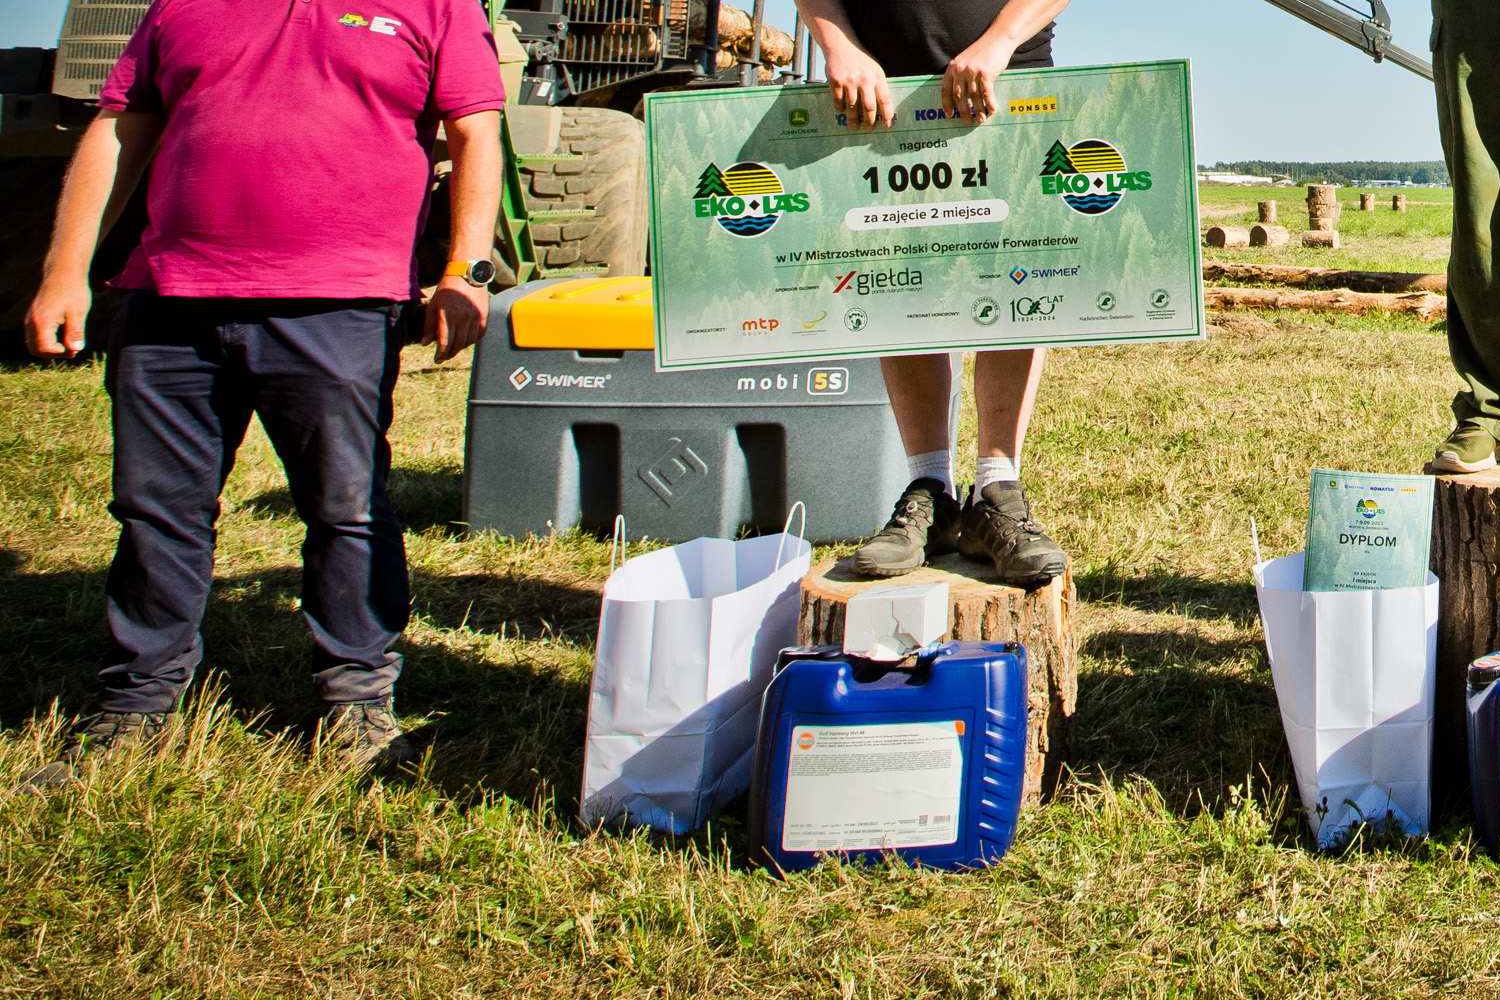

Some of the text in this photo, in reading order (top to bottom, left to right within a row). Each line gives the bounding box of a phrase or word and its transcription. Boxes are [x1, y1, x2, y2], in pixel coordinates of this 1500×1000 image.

[1010, 102, 1057, 112] PONSSE
[900, 138, 948, 152] nagroda
[862, 160, 989, 194] 1 000 zł
[1041, 170, 1152, 195] EKO LAS
[694, 192, 810, 218] EKO LAS
[864, 206, 991, 224] za zajęcie 2 miejsca
[776, 235, 1079, 262] w IV Mistrzostwach Polski Operatorów Forwarderów
[857, 268, 923, 296] giełda
[1047, 295, 1064, 304] LAT
[742, 318, 779, 332] mtp
[736, 372, 843, 390] mobi 5S
[1340, 534, 1396, 547] DYPLOM
